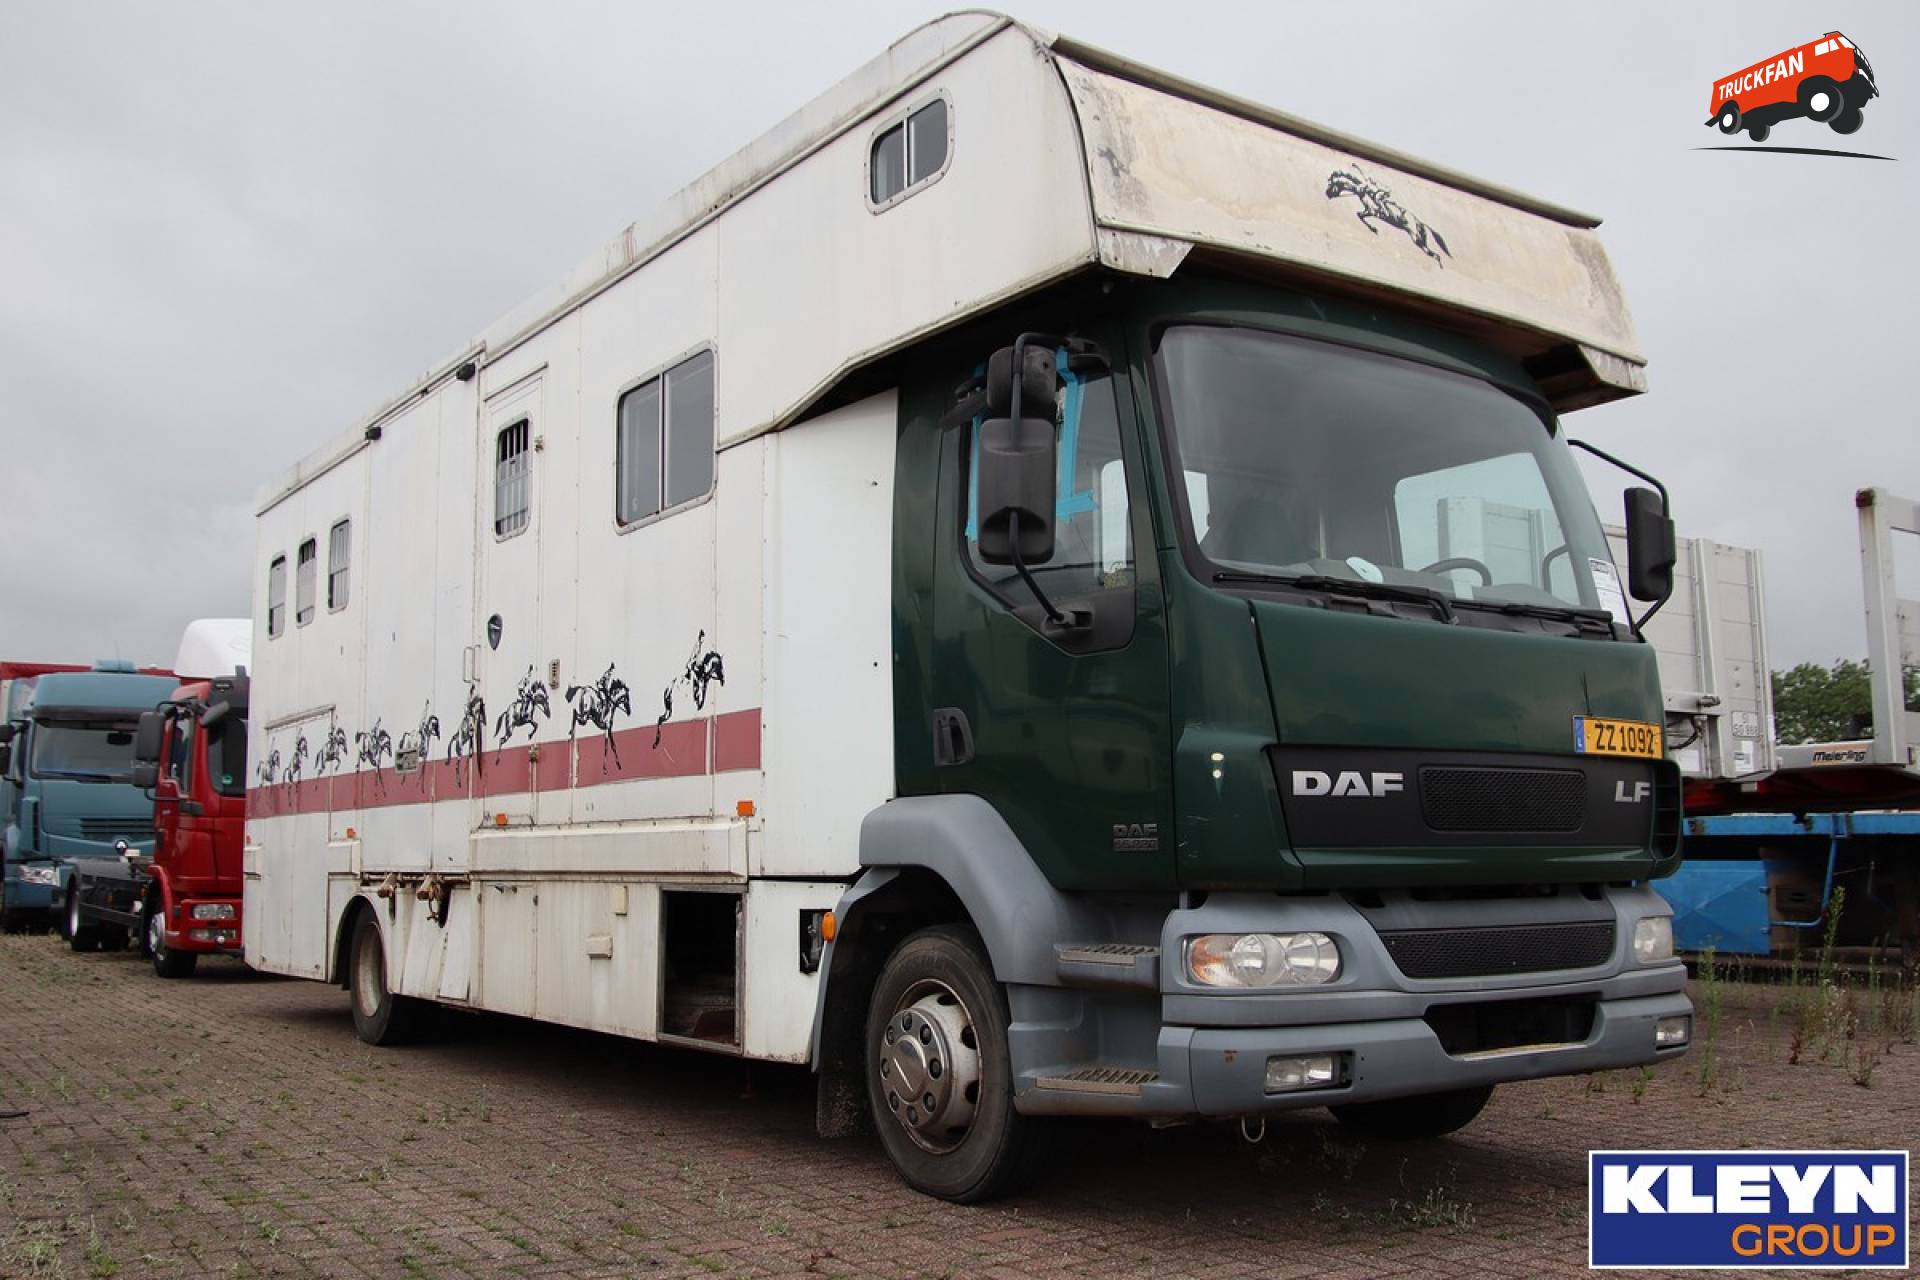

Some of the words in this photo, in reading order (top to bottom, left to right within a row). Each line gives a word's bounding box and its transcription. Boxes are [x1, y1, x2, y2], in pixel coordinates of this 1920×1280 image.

[1292, 770, 1404, 798] DAF
[1615, 780, 1651, 803] LF
[1113, 823, 1158, 837] DAF
